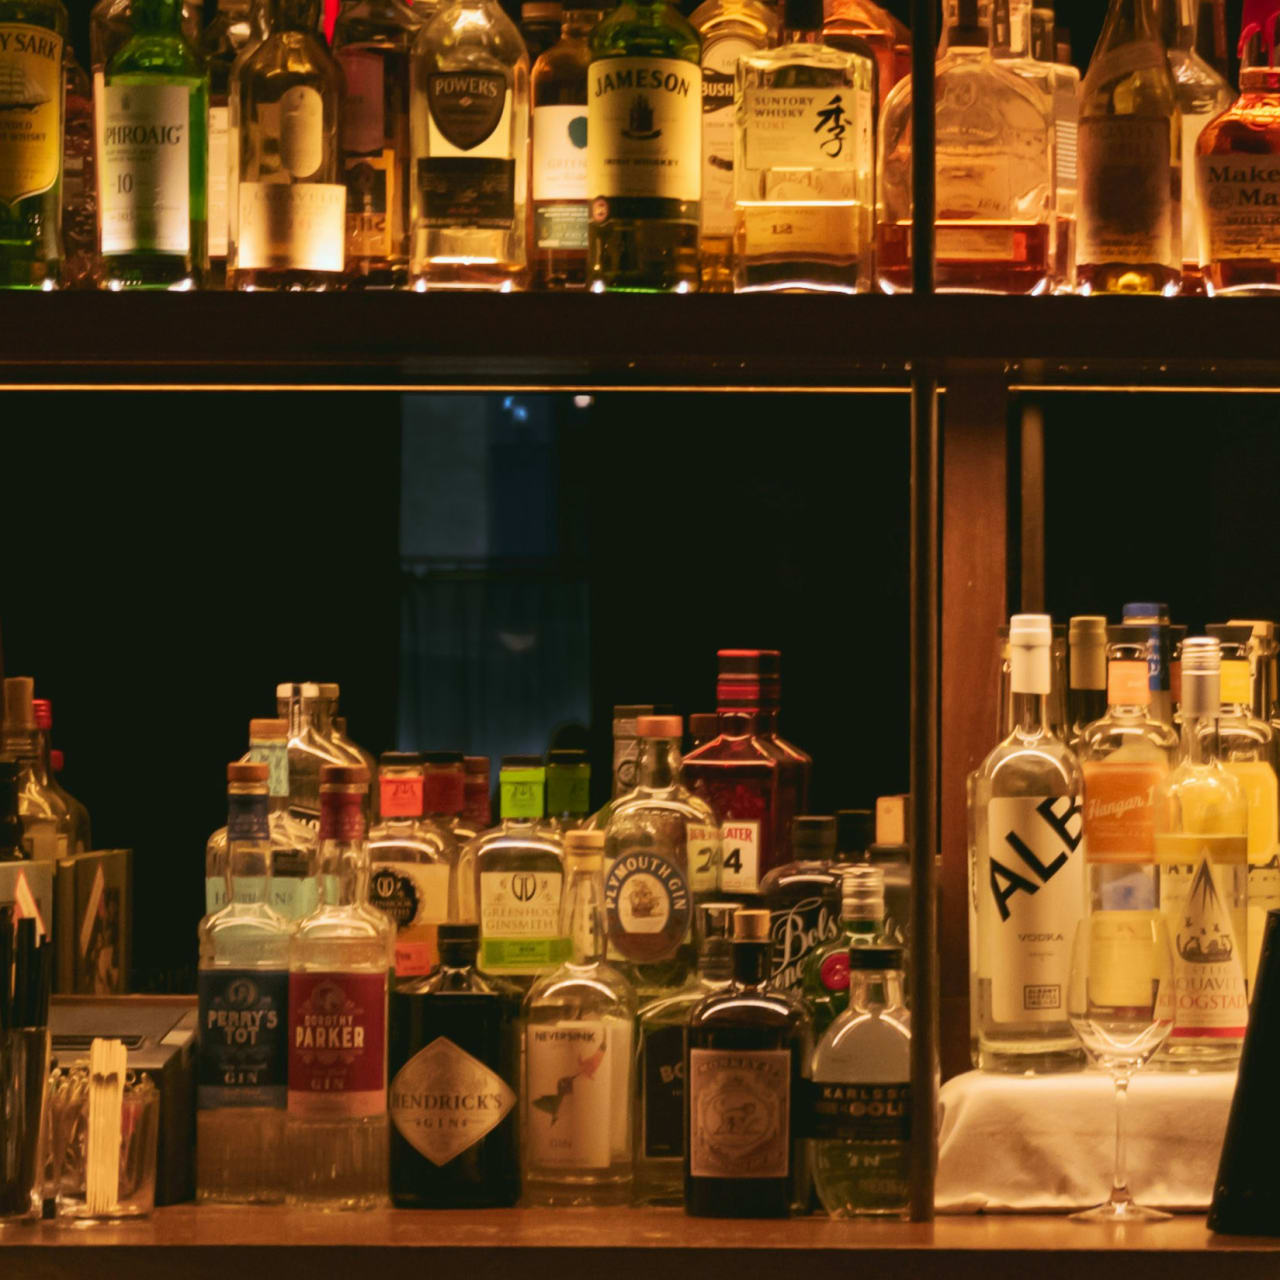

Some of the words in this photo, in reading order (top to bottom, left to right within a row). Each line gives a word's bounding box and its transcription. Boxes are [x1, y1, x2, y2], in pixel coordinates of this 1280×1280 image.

[15, 30, 57, 60] SARK
[435, 76, 498, 99] POWERS
[594, 67, 691, 98] JAMESON
[755, 96, 814, 107] SUNTORY
[755, 109, 803, 119] WHISKY
[105, 125, 181, 146] PHROAIG
[989, 796, 1083, 923] ALB
[605, 855, 672, 910] PLYMOUTH
[668, 877, 688, 912] GIN
[486, 919, 555, 931] GINSMITH
[1018, 932, 1064, 943] VODKA
[207, 1008, 278, 1030] PERRY'S
[223, 1026, 259, 1045] TOT
[295, 1026, 365, 1049] PARKER
[534, 1031, 596, 1043] NEVERSINK
[223, 1070, 259, 1084] GIN
[309, 1077, 345, 1090] GIN
[390, 1094, 504, 1112] HENDRICK'S
[417, 1117, 454, 1129] GIN
